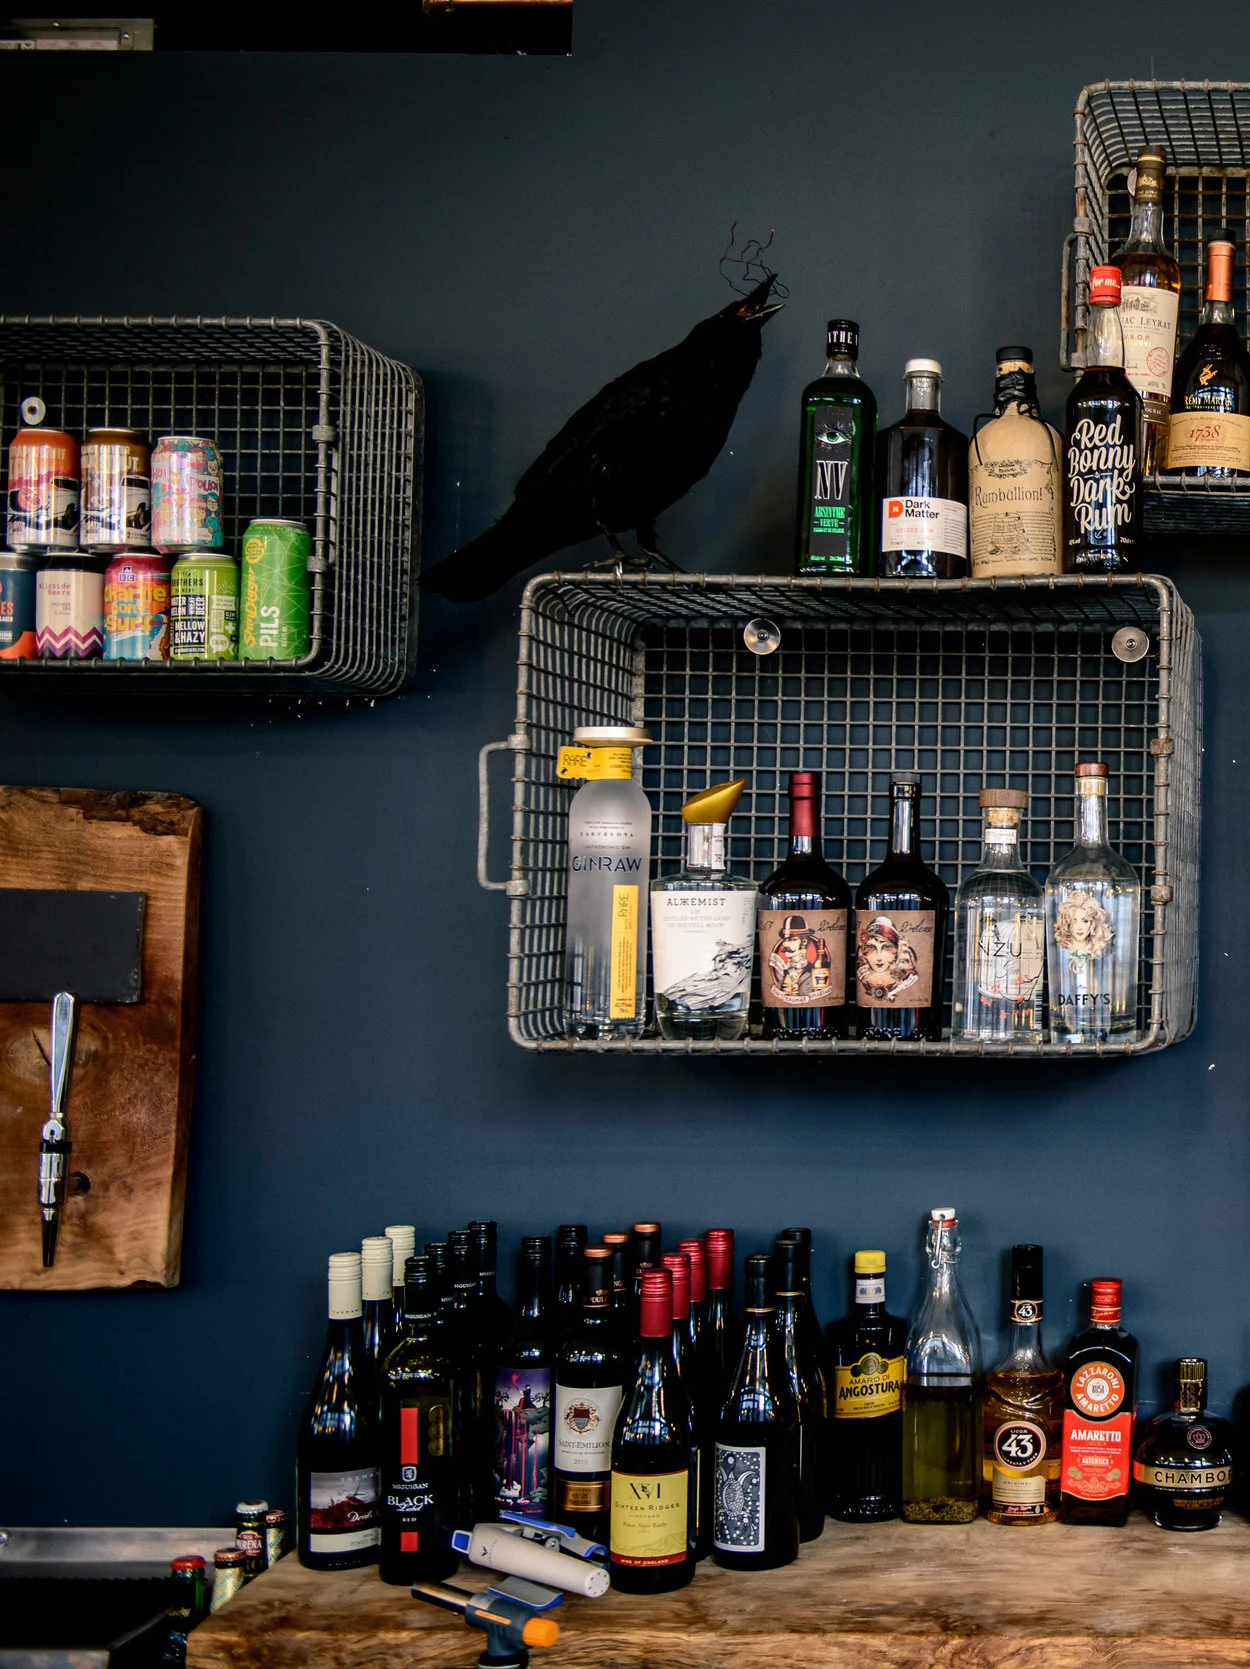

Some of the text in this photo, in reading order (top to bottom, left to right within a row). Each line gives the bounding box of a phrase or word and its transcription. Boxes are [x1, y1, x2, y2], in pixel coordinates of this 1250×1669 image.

[1092, 277, 1104, 291] for
[1140, 316, 1171, 330] LEYRAT
[1203, 395, 1233, 406] MARTIN
[1072, 414, 1124, 450] Red
[1189, 424, 1221, 442] 1738
[1068, 444, 1136, 482] Bonny
[814, 460, 848, 500] NV
[1070, 469, 1136, 507] Dark
[905, 499, 930, 509] Dark
[975, 486, 1043, 508] Rumbullion!
[905, 508, 940, 519] Matter
[1075, 503, 1132, 534] Rum
[47, 589, 71, 597] Beers
[104, 585, 167, 602] Charlie
[105, 615, 153, 634] Surf
[174, 621, 205, 631] MELLOW
[259, 606, 281, 648] PILS
[571, 855, 642, 873] GINRAW
[1058, 993, 1111, 1006] DAFFY'S
[1017, 1304, 1034, 1317] 43
[849, 1376, 881, 1385] AMARO
[1076, 1366, 1121, 1389] LAZZARONI
[838, 1380, 900, 1401] ANGOSTURA
[1075, 1392, 1119, 1413] AMARETTO
[1070, 1428, 1122, 1443] AMARETTO
[1001, 1433, 1034, 1458] 43
[387, 1494, 434, 1506] BLACK
[615, 1501, 680, 1511] SIXTEEN RIDGES
